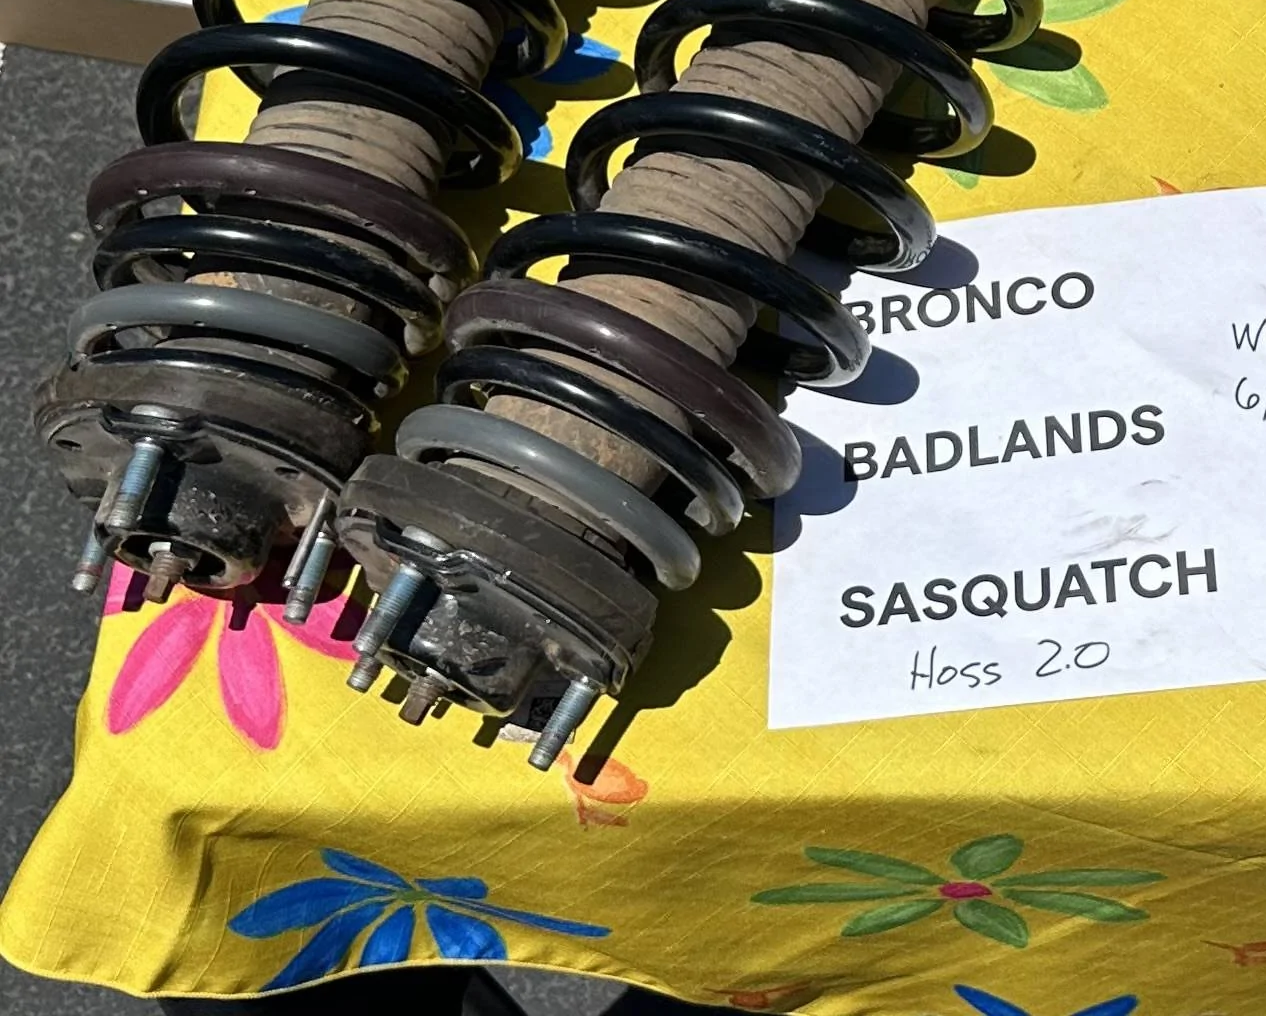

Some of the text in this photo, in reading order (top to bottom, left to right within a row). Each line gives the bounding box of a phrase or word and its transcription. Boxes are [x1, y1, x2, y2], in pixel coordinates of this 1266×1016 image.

[845, 271, 1095, 335] BRONCO
[844, 404, 1165, 482] BADLANDS
[840, 548, 1218, 628] SASQUATCH
[1036, 638, 1110, 677] 2.0
